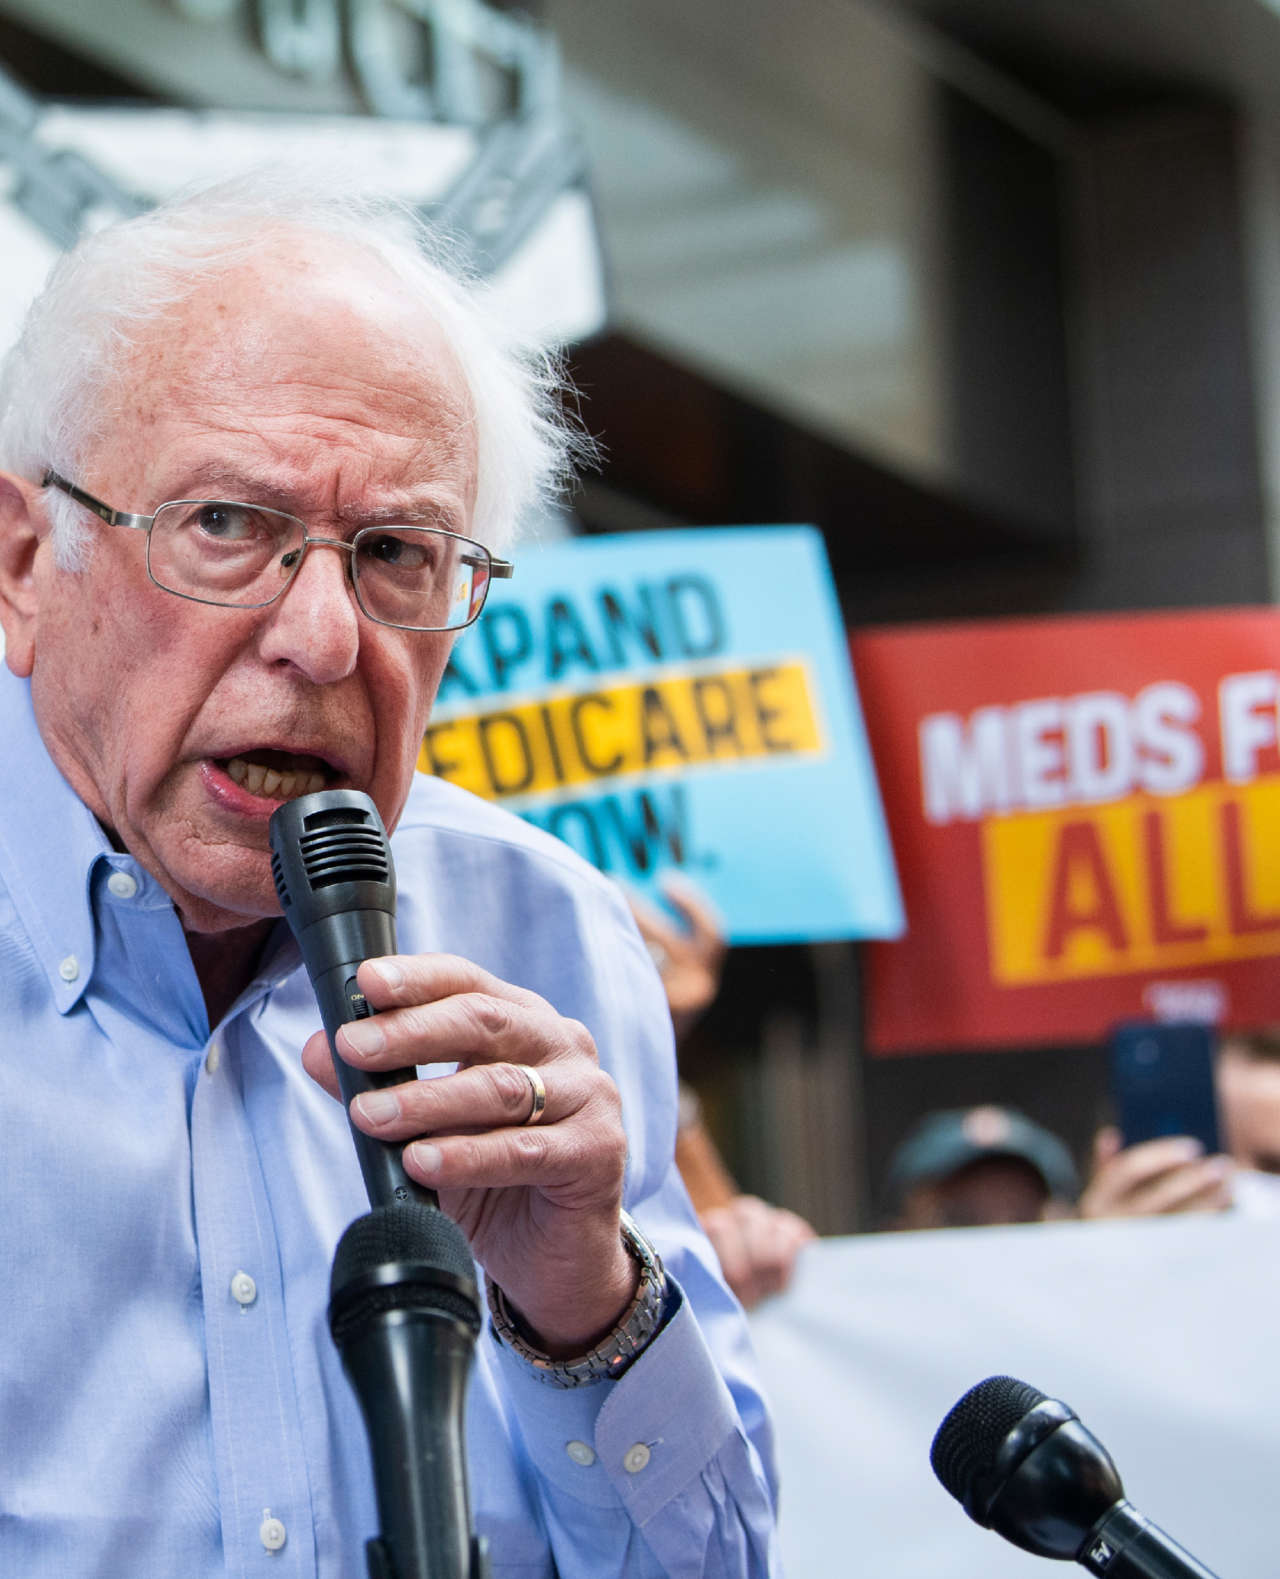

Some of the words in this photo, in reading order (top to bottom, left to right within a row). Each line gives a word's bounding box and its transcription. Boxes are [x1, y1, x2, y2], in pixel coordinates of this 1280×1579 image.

[921, 681, 1205, 827] MEDS
[1219, 669, 1280, 786] F
[520, 785, 718, 876] OW.
[1042, 800, 1280, 960] ALL
